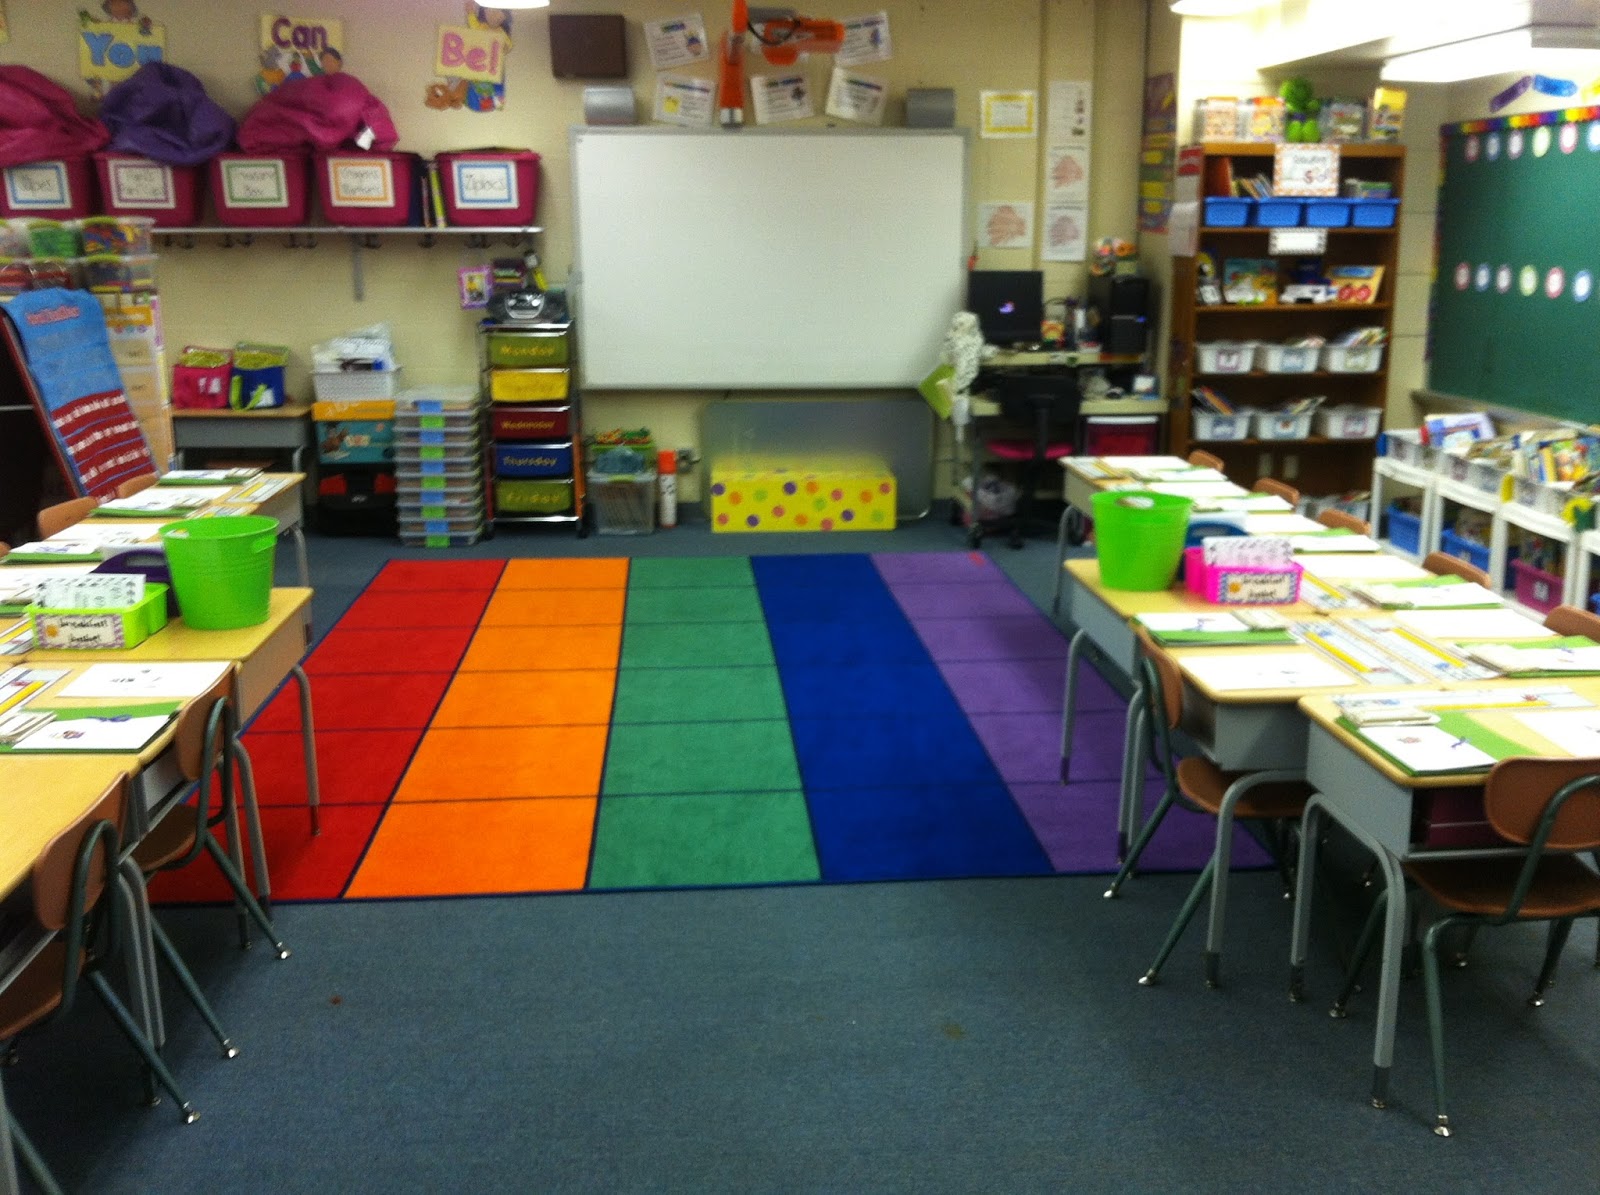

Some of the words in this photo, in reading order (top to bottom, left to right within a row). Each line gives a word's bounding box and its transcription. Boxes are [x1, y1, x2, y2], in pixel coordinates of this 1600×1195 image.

[271, 17, 328, 51] Can
[81, 31, 164, 68] You
[501, 345, 555, 357] Monday
[503, 456, 557, 467] Thursday
